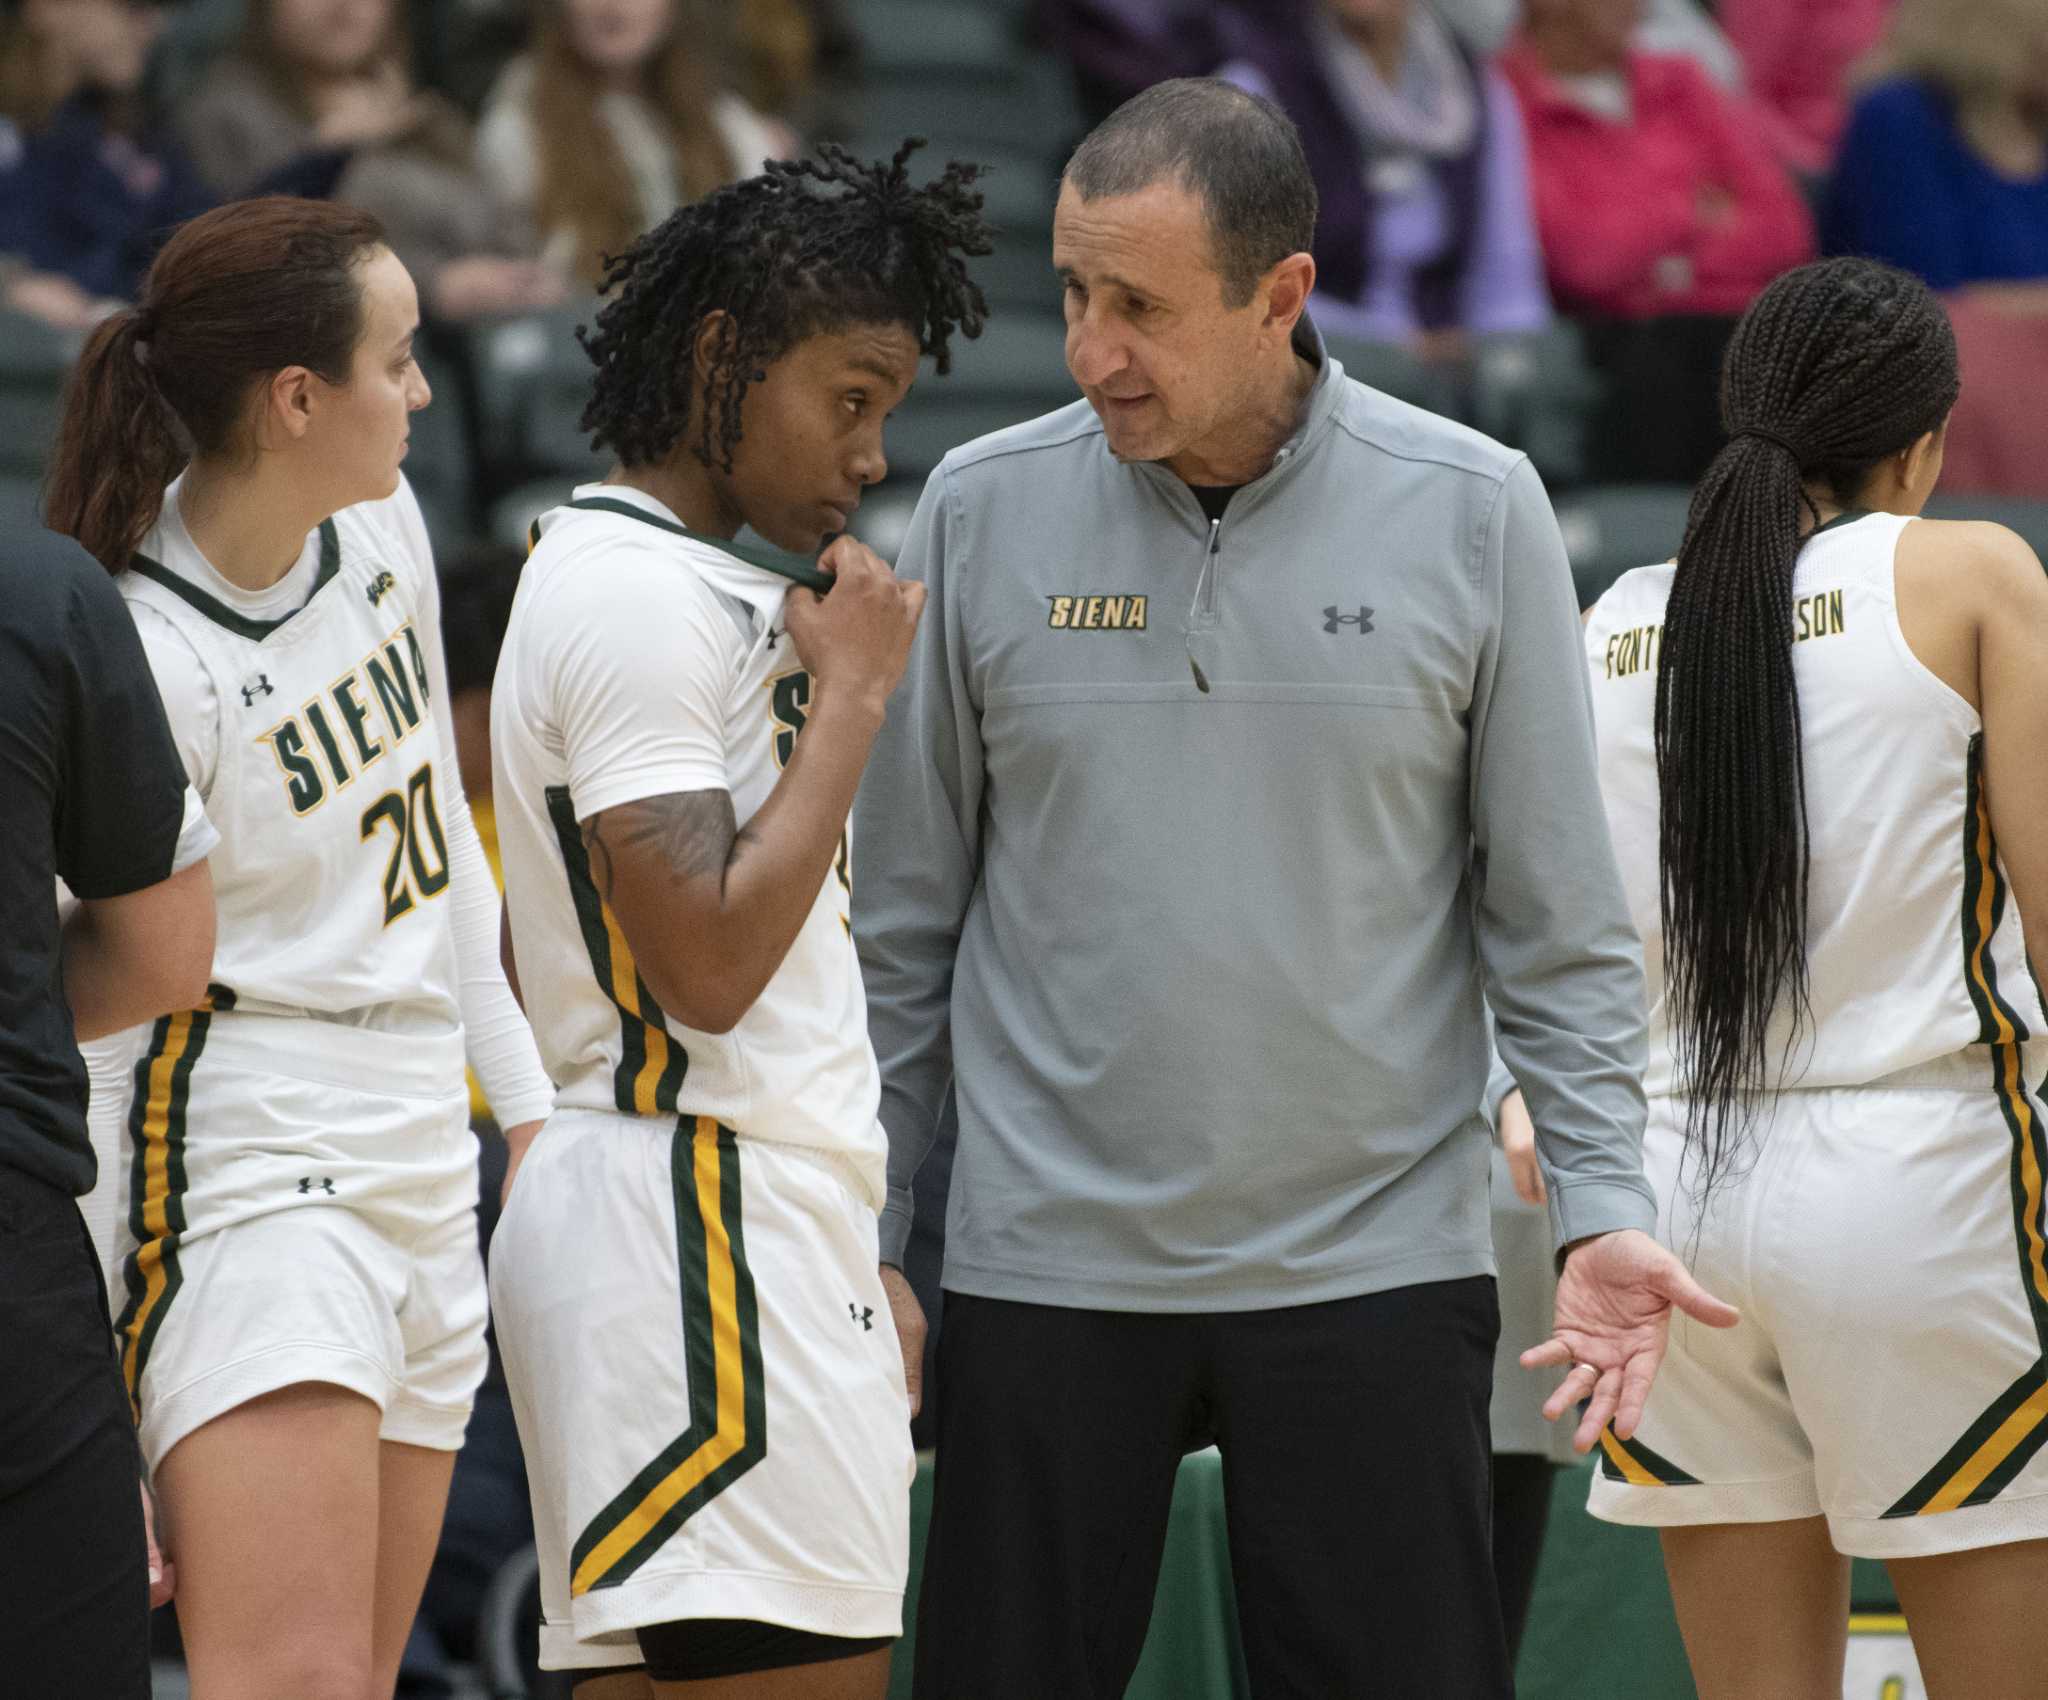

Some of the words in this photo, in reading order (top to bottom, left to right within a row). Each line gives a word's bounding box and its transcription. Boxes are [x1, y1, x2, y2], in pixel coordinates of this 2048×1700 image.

[1045, 594, 1147, 630] SIENA
[1792, 589, 1844, 643] SON
[258, 618, 430, 817] SIENA
[361, 763, 449, 929] 20
